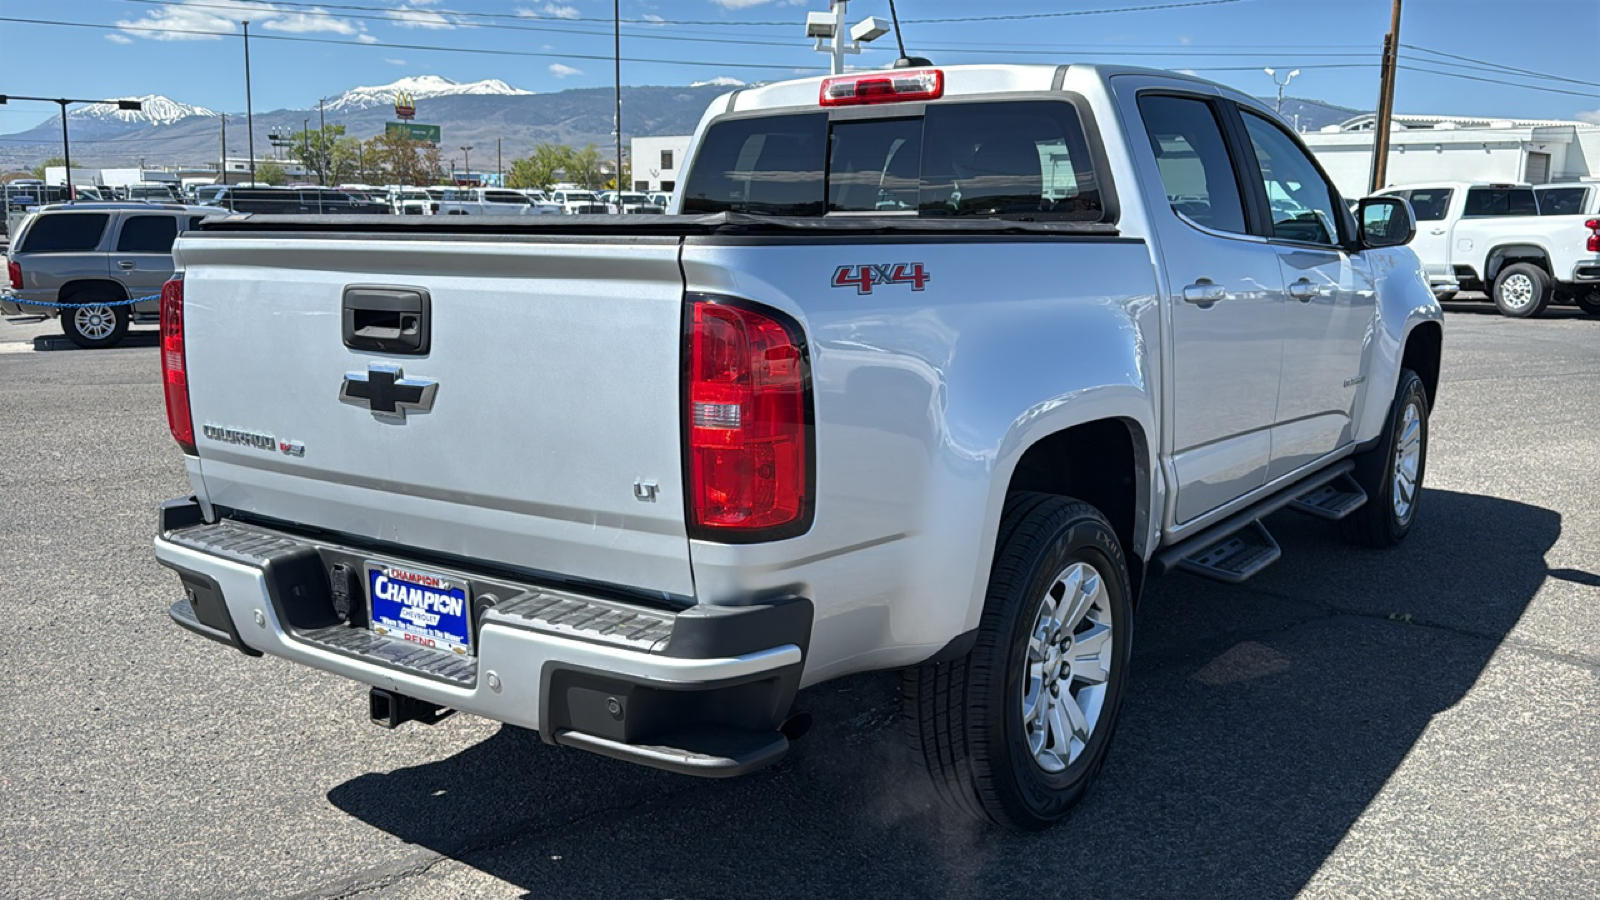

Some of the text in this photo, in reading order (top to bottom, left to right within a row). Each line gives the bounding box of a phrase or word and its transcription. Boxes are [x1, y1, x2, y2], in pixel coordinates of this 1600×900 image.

[203, 424, 276, 452] COLORADO
[634, 481, 660, 503] LT
[391, 568, 441, 587] CHAMPION
[401, 608, 438, 623] CHEVROLET
